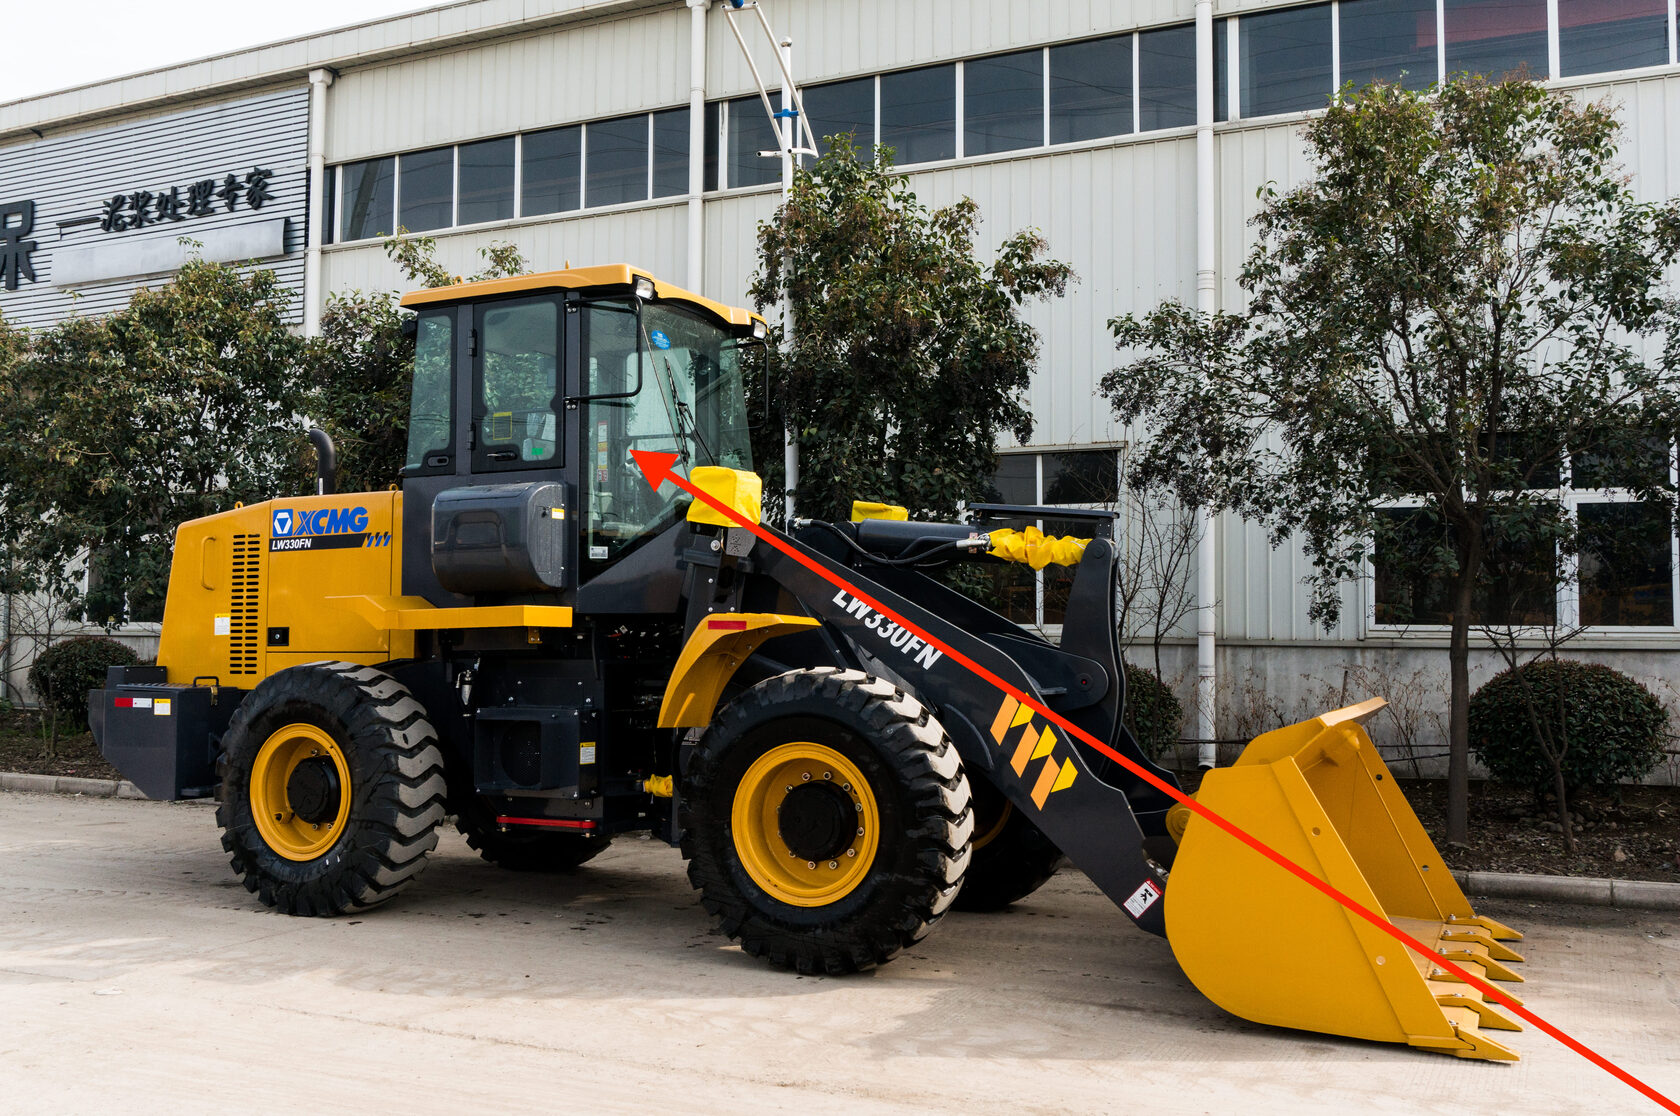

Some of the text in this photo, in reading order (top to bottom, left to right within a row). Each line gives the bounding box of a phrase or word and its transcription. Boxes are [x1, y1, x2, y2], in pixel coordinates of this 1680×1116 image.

[293, 506, 369, 536] XCMG
[271, 538, 312, 550] LW330FN
[832, 588, 943, 671] LW330FN
